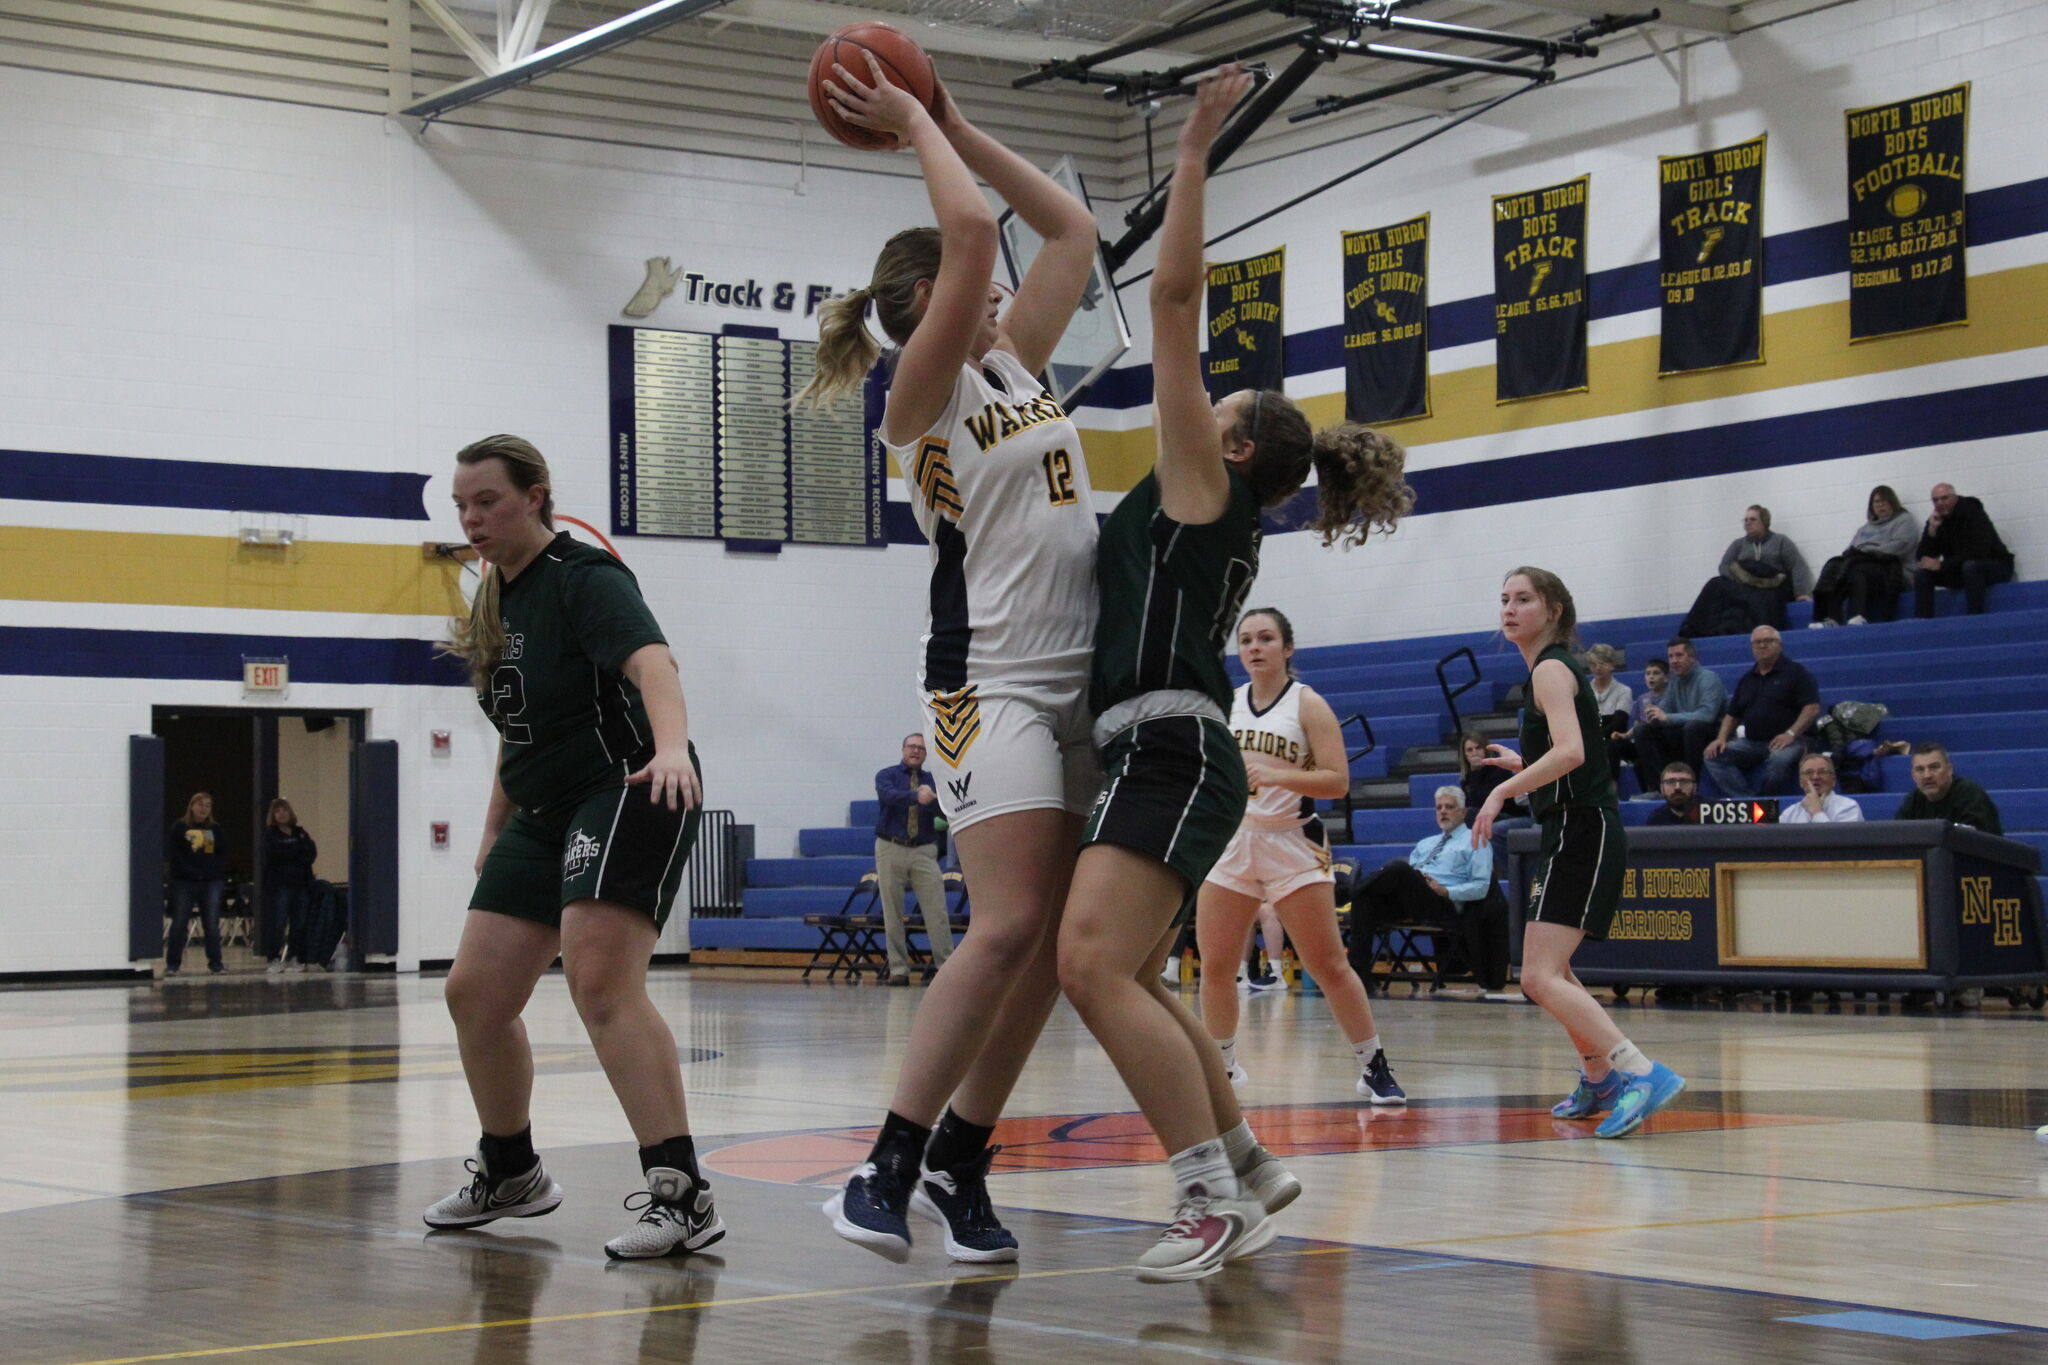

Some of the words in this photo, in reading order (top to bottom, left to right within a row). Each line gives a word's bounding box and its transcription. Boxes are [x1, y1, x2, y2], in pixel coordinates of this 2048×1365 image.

[1851, 107, 1901, 138] NORTH
[1910, 91, 1963, 125] HURON
[1884, 126, 1928, 156] BOYS
[1663, 156, 1706, 184] NORTH
[1714, 144, 1761, 174] HURON
[1853, 152, 1961, 202] FOOTBALL
[1496, 195, 1535, 221] NORTH
[1542, 183, 1584, 211] HURON
[1689, 175, 1733, 202] GIRLS
[1523, 213, 1557, 238] BOYS
[1671, 201, 1752, 236] TRACK
[1345, 233, 1381, 256] NORTH
[1386, 221, 1425, 247] HURON
[1850, 225, 1893, 246] LEAGUE
[1367, 249, 1403, 273] GIRLS
[1504, 236, 1577, 271] TRACK
[1209, 264, 1241, 286] NORTH
[1245, 253, 1281, 279] HURON
[1661, 269, 1700, 287] LEAGUE
[1852, 267, 1902, 288] REGIONAL
[684, 273, 763, 308] Track
[772, 282, 796, 312] &
[1231, 280, 1259, 303] BOYS
[1346, 278, 1375, 309] CROSS
[1380, 272, 1423, 295] COUNTRY
[1209, 307, 1237, 337] CROSS
[1240, 302, 1280, 323] COUNTRY
[1496, 300, 1530, 318] LEAGUE
[1344, 332, 1377, 348] LEAGUE
[1209, 358, 1239, 374] LEAGUE
[1042, 448, 1078, 507] 12
[619, 473, 629, 527] RECORDS
[872, 487, 881, 539] RECORDS
[254, 666, 279, 687] EXIT
[1234, 729, 1300, 764] RRIORS
[1700, 802, 1752, 824] POSS.
[1642, 868, 1711, 898] HURON
[1608, 910, 1693, 940] ARRIORS
